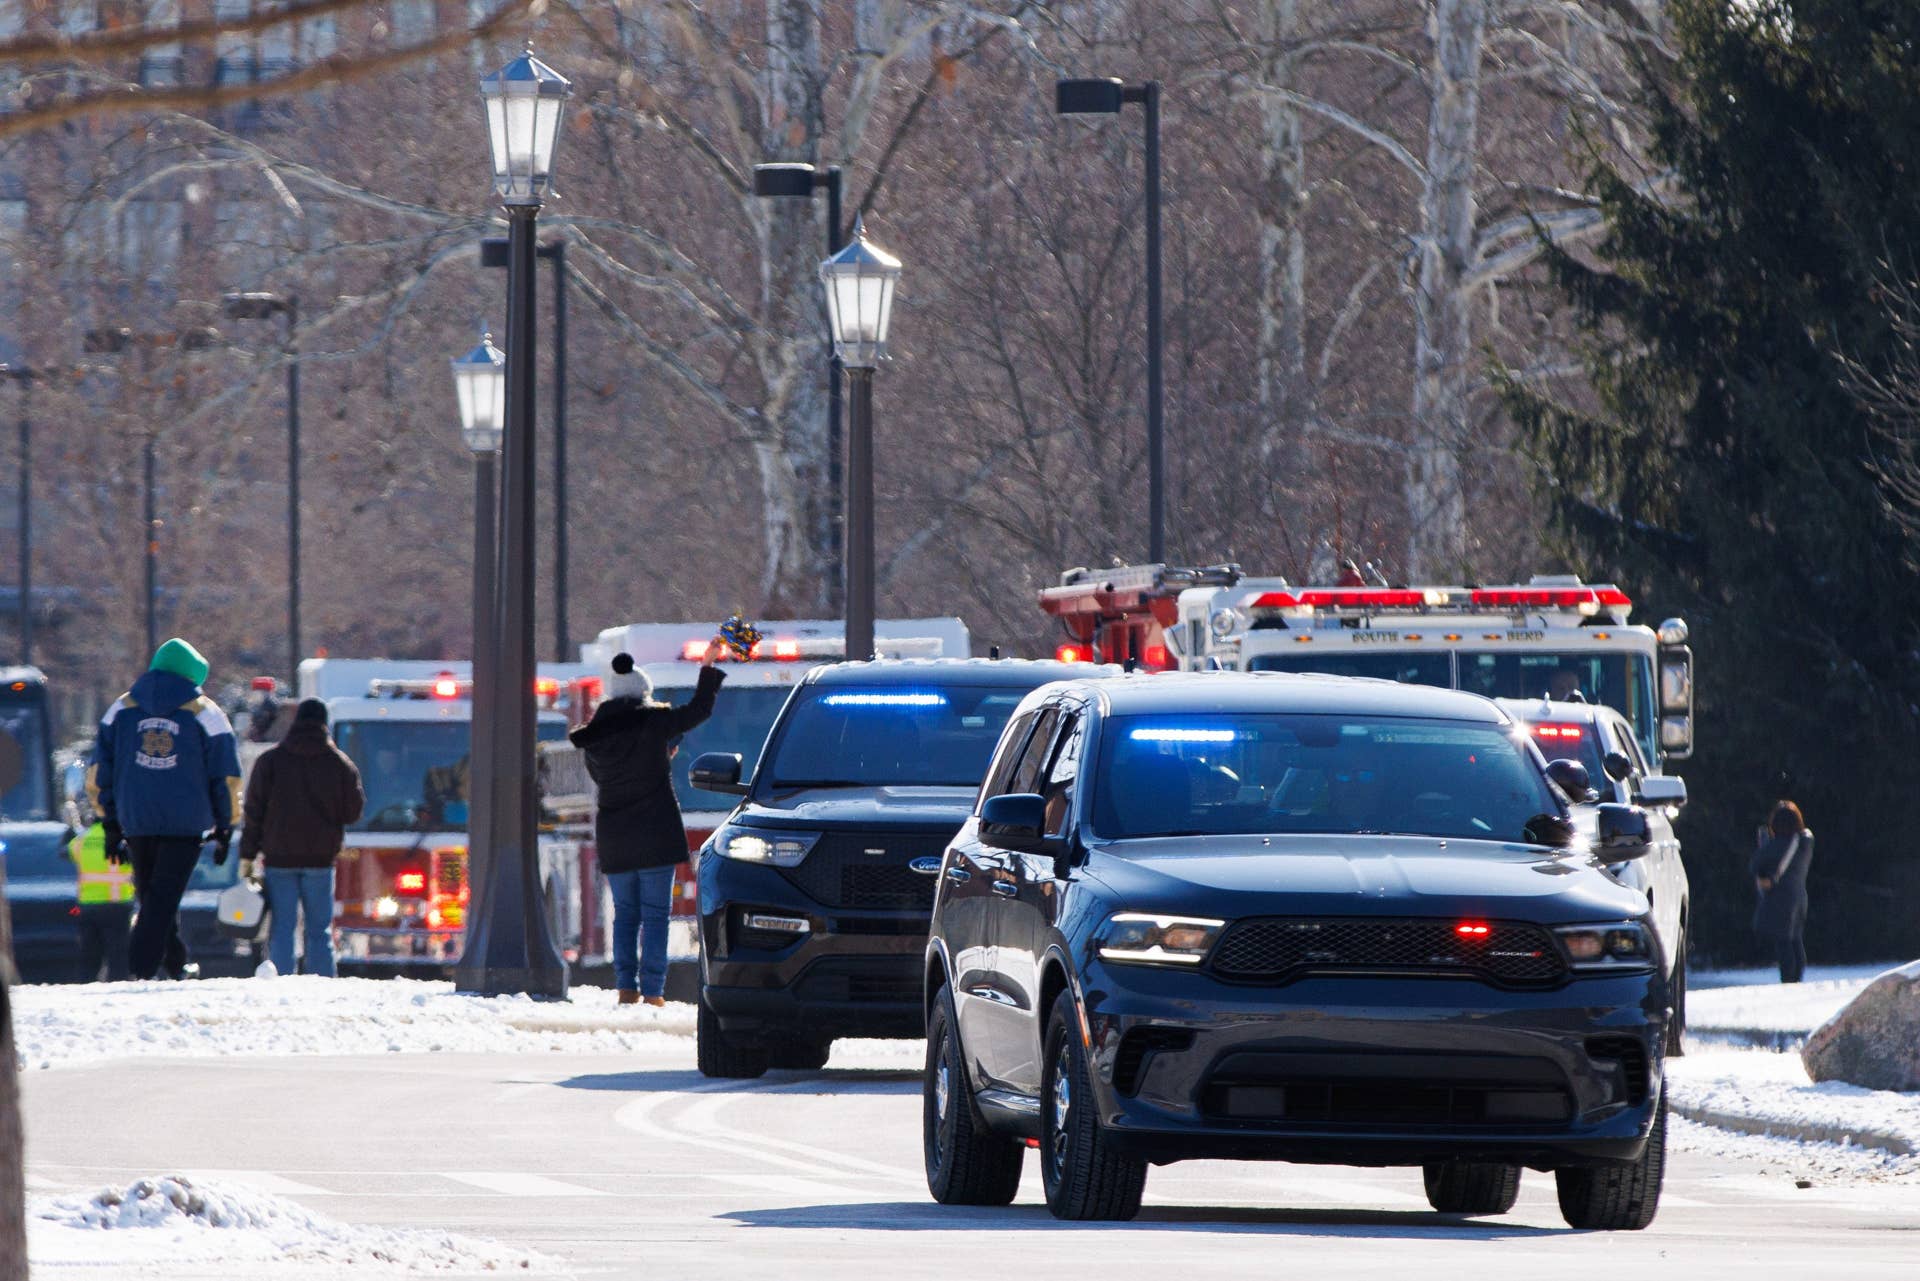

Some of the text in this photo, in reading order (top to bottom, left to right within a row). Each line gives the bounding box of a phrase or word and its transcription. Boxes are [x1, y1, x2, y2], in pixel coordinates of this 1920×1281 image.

[1352, 630, 1545, 642] SOUTH BEND
[136, 751, 178, 769] IRISH
